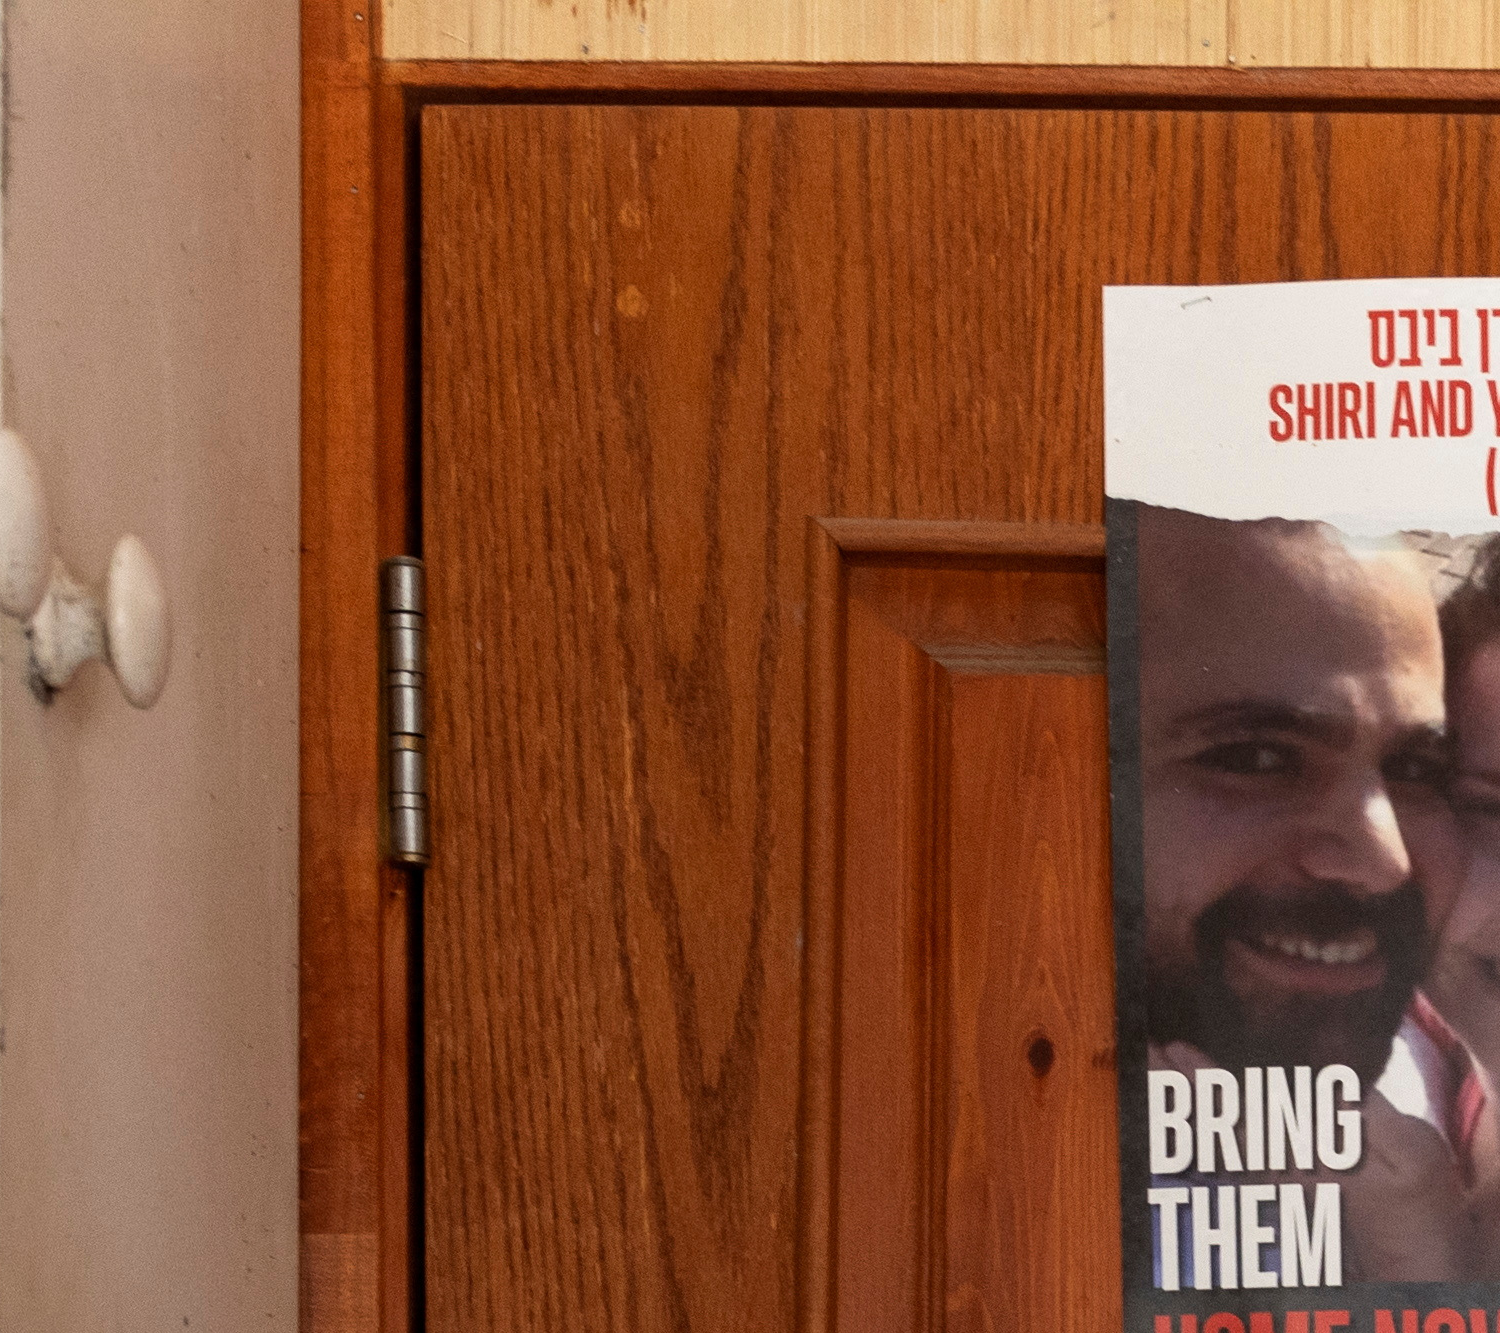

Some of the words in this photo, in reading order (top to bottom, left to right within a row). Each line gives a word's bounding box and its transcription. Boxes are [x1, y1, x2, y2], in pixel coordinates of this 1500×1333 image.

[1366, 308, 1463, 369] ביבס
[1268, 380, 1377, 443] SHIRI
[1390, 379, 1474, 439] AND
[1147, 1064, 1362, 1175] BRING
[1148, 1182, 1342, 1291] THEM
